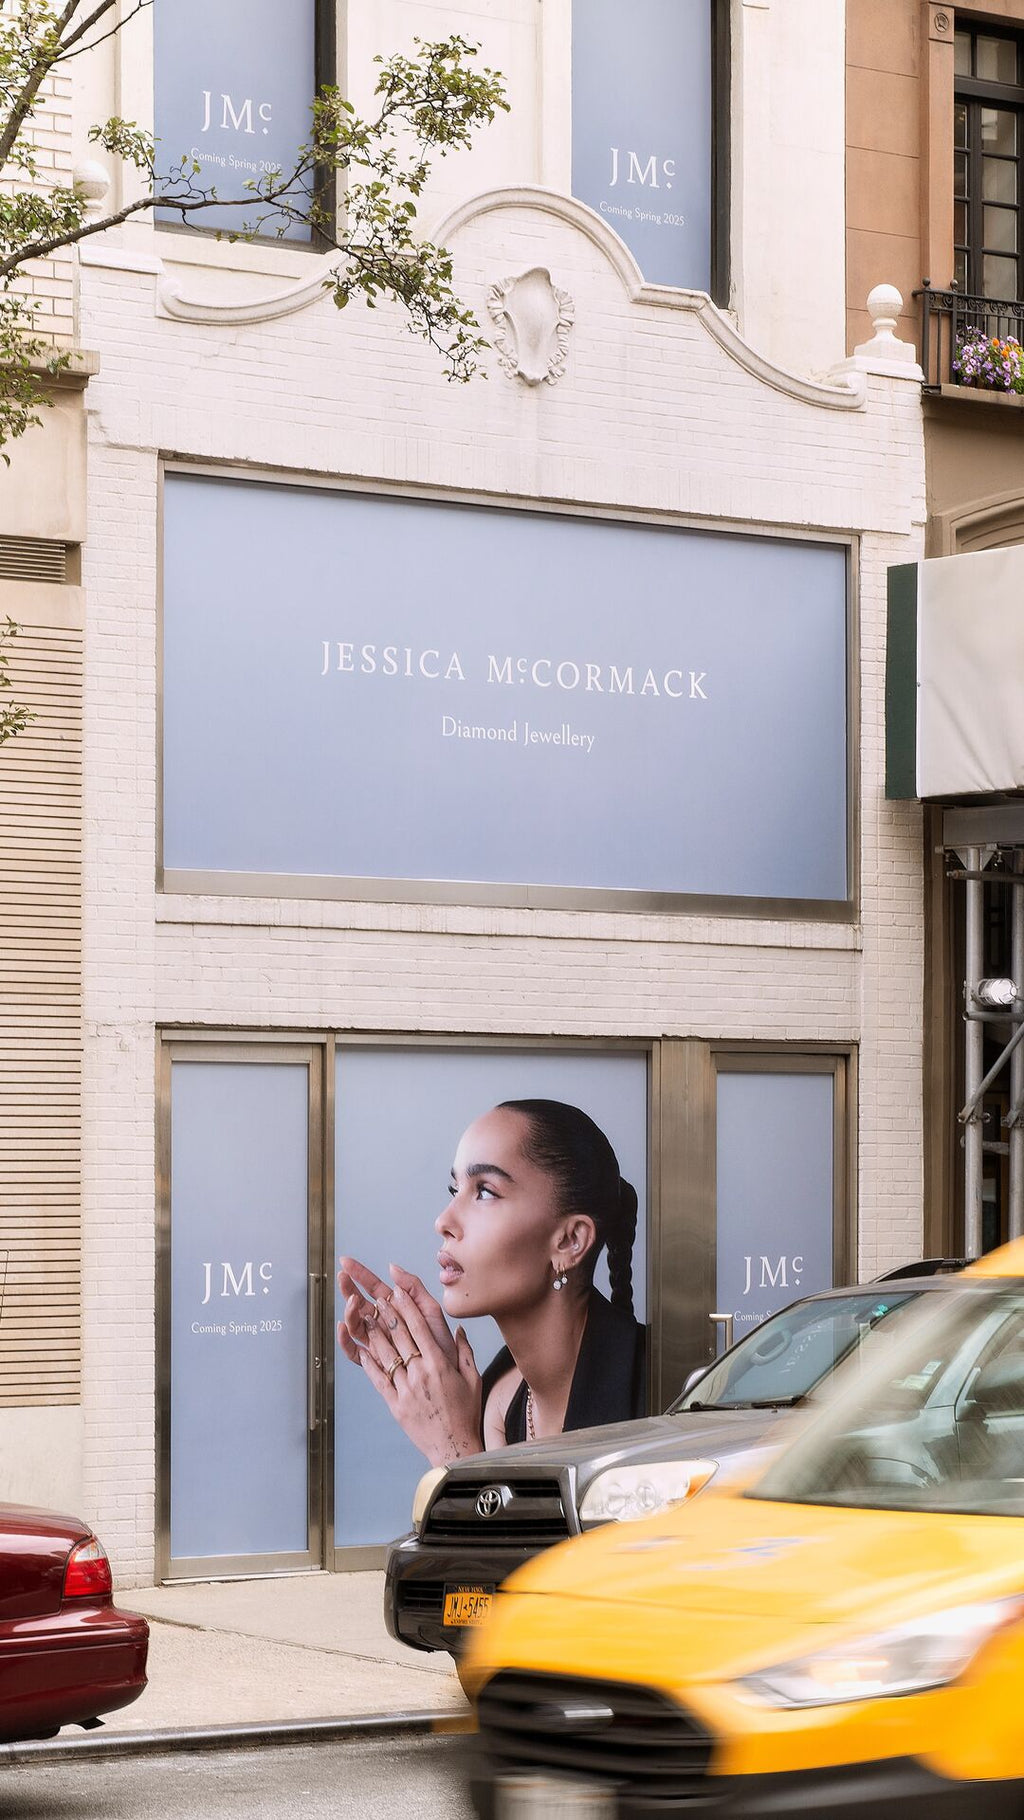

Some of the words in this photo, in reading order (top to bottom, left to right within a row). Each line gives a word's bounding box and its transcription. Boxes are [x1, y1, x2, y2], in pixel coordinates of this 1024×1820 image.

[190, 147, 226, 167] Coming
[229, 154, 257, 172] Spring
[599, 201, 632, 219] Coming
[635, 207, 661, 224] Spring
[663, 213, 685, 226] 2025
[321, 641, 466, 680] JESSICA
[442, 715, 518, 742] Diamond
[523, 722, 595, 753] Jewellery
[191, 1321, 227, 1336] Coming
[229, 1321, 258, 1336] Spring
[259, 1320, 283, 1332] 2025
[733, 1311, 765, 1324] Coming
